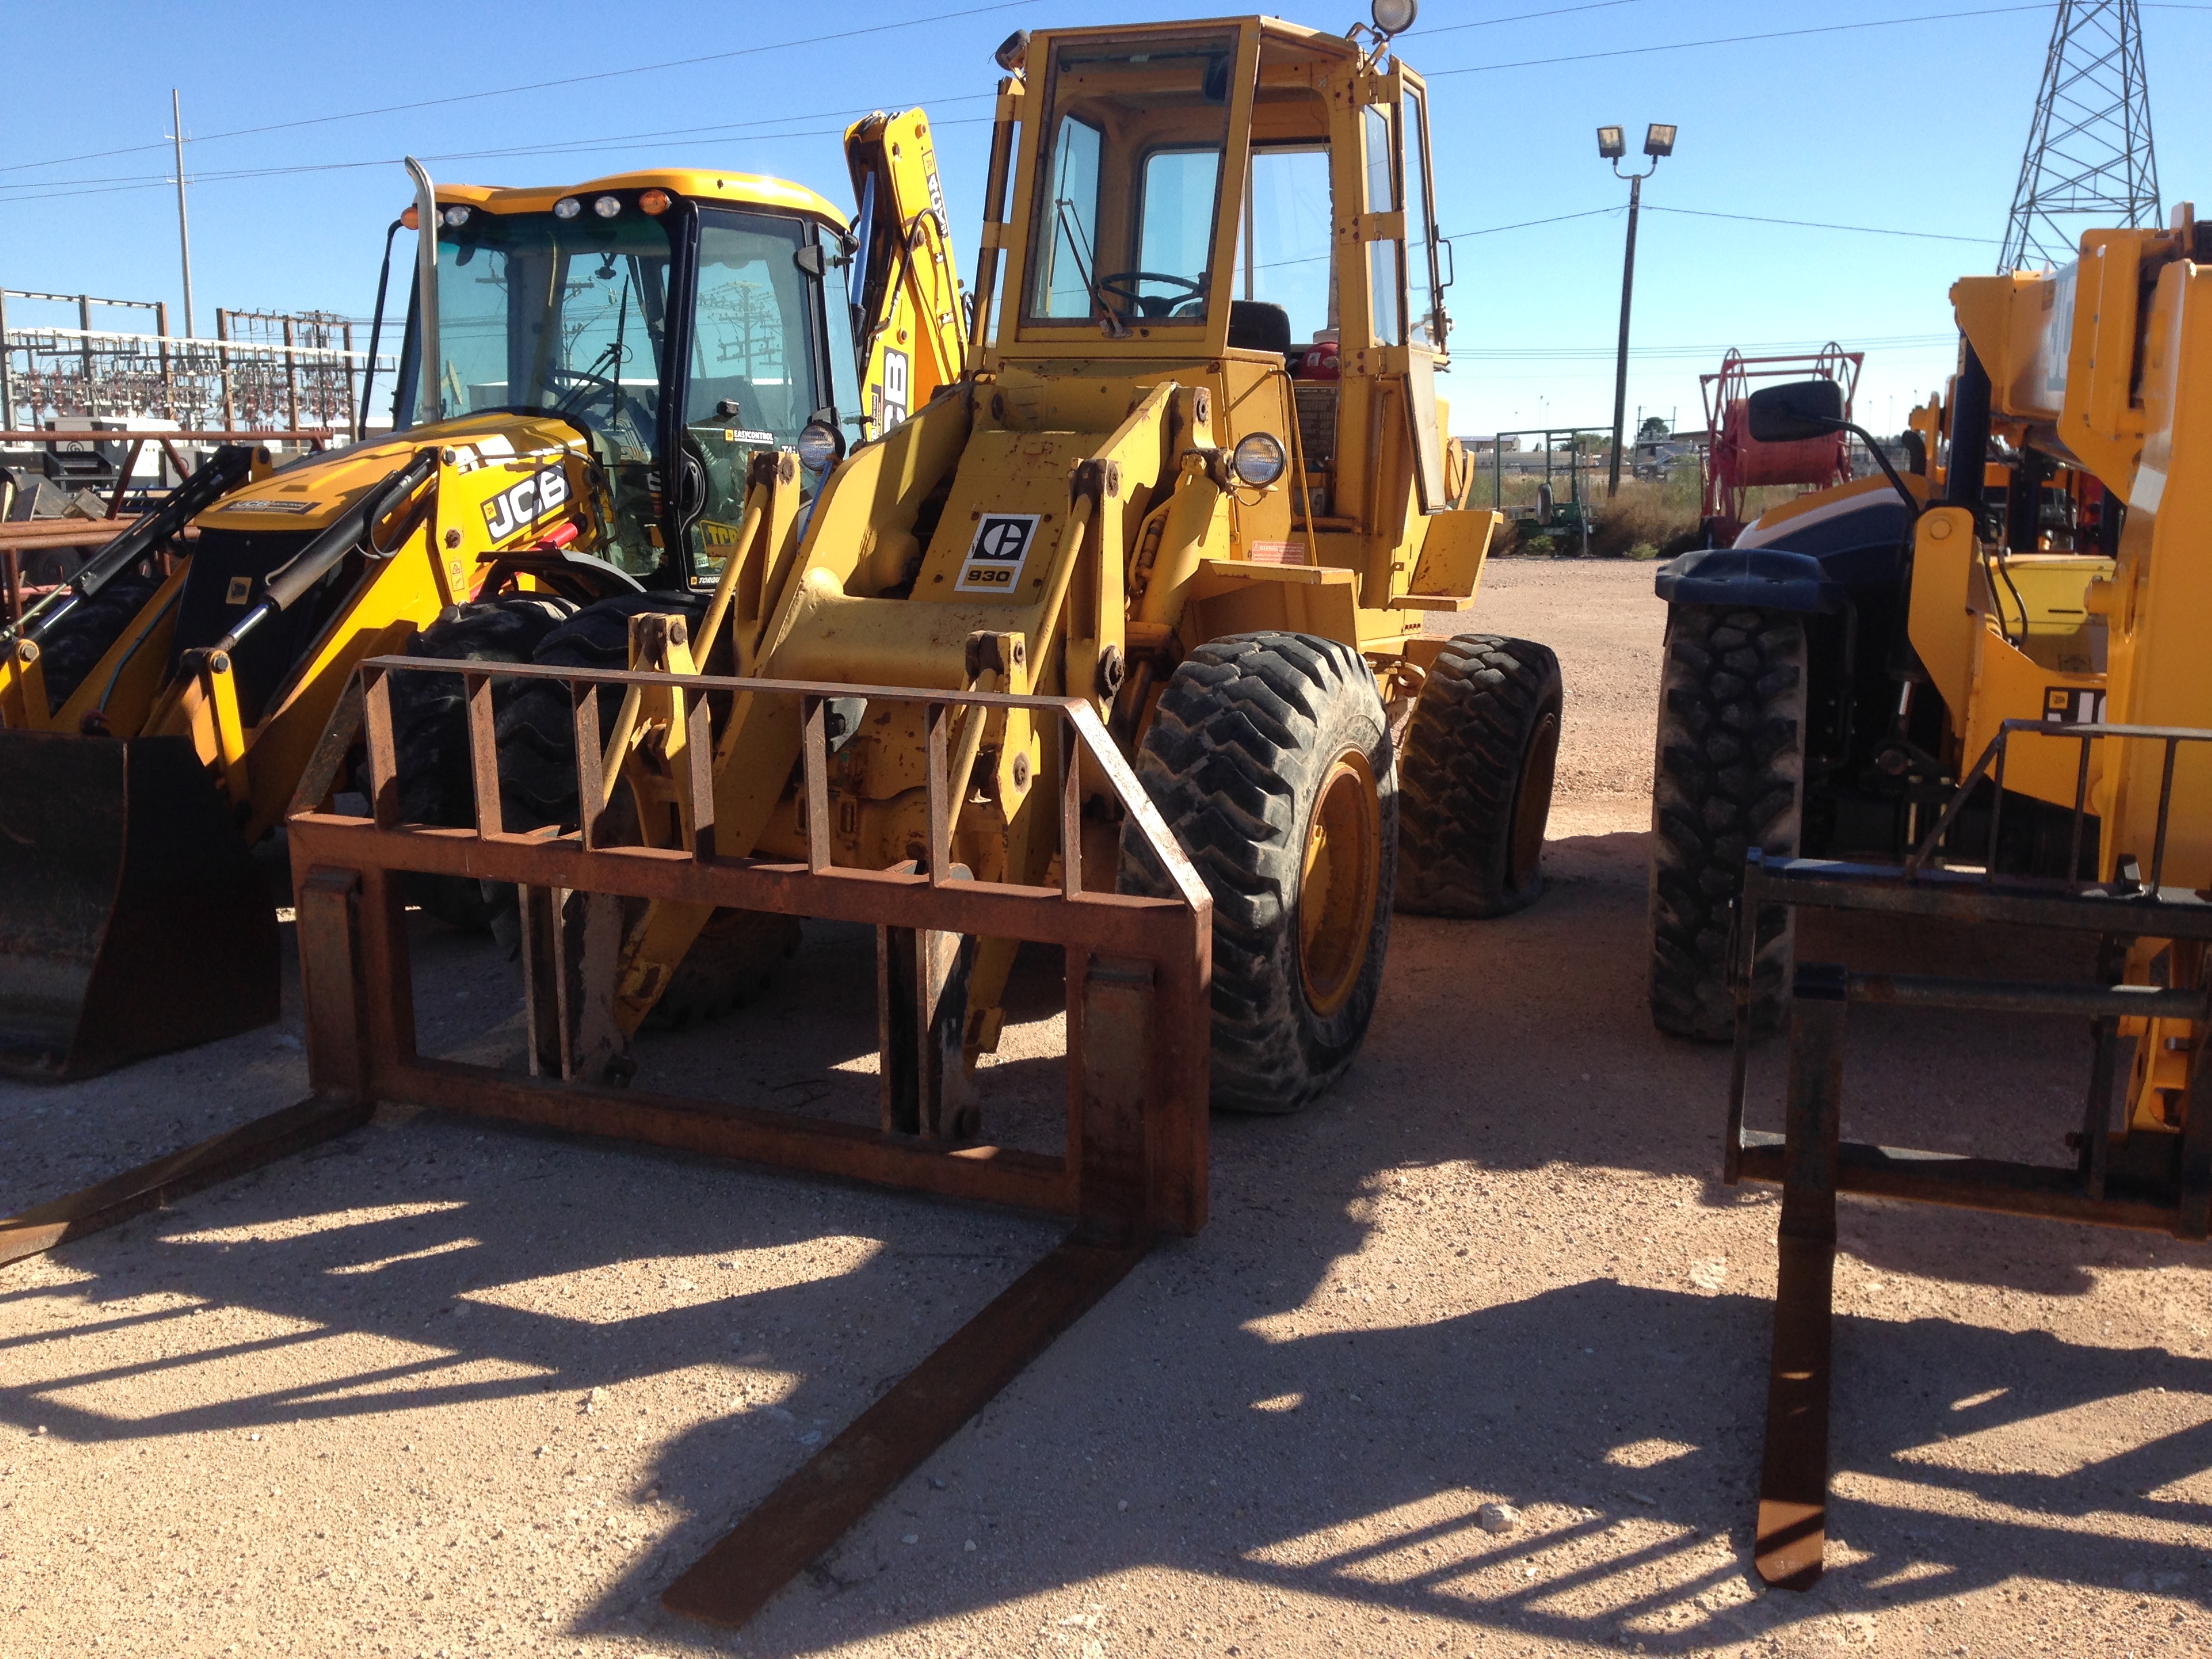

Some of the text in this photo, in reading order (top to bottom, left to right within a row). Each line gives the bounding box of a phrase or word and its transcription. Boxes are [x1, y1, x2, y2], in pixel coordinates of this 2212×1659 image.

[734, 430, 774, 441] EASYCONTROL
[489, 466, 569, 538] JCB
[968, 571, 1010, 582] 930
